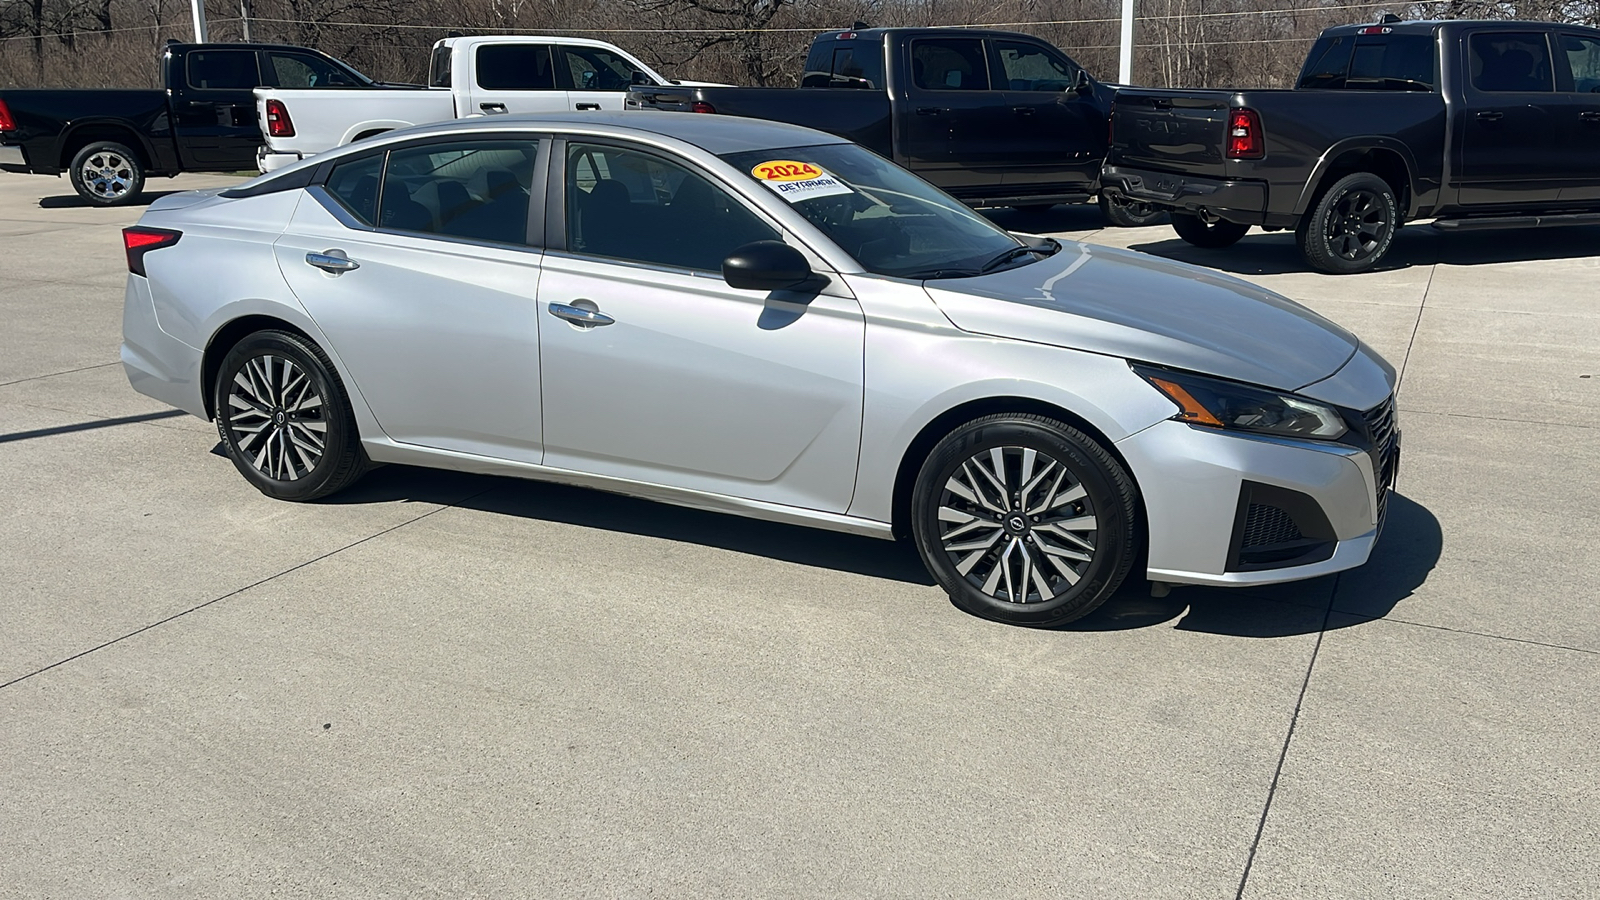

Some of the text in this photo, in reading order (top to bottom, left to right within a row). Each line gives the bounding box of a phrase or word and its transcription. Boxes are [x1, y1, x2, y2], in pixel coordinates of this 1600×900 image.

[761, 164, 818, 180] 2024
[778, 178, 836, 192] DEYARMAN
[1052, 579, 1102, 617] KUMHO
